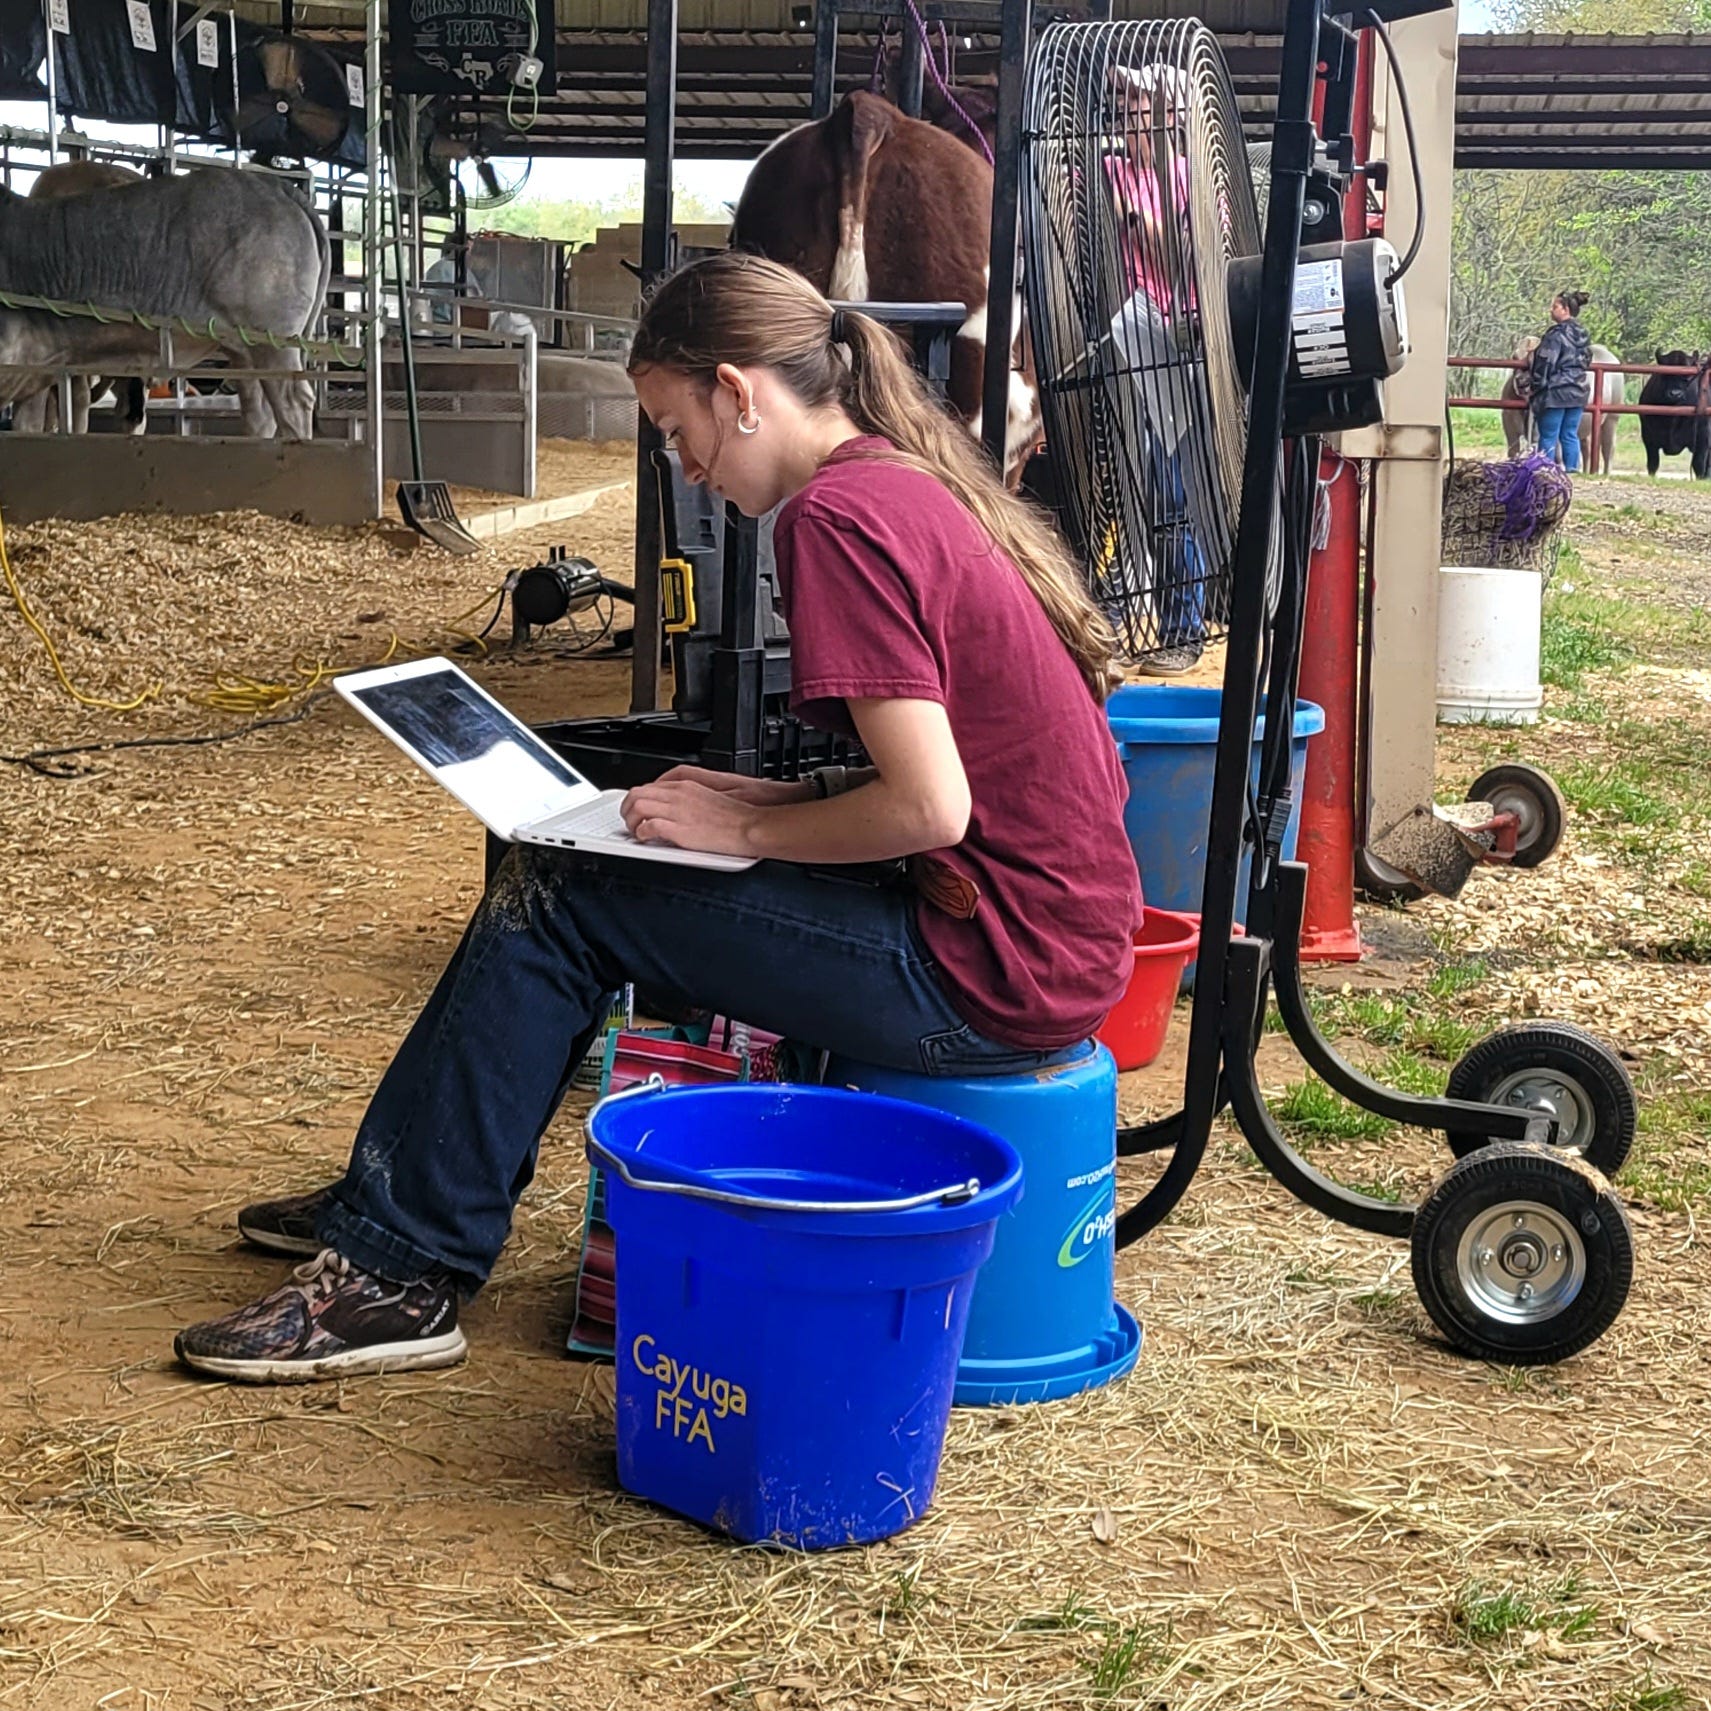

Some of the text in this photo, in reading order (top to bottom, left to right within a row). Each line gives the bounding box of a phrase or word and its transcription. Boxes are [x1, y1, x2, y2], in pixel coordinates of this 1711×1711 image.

[446, 19, 499, 46] FFA
[430, 1298, 450, 1331] ARIAT
[632, 1334, 747, 1418] Cayuga
[655, 1388, 716, 1453] FFA
